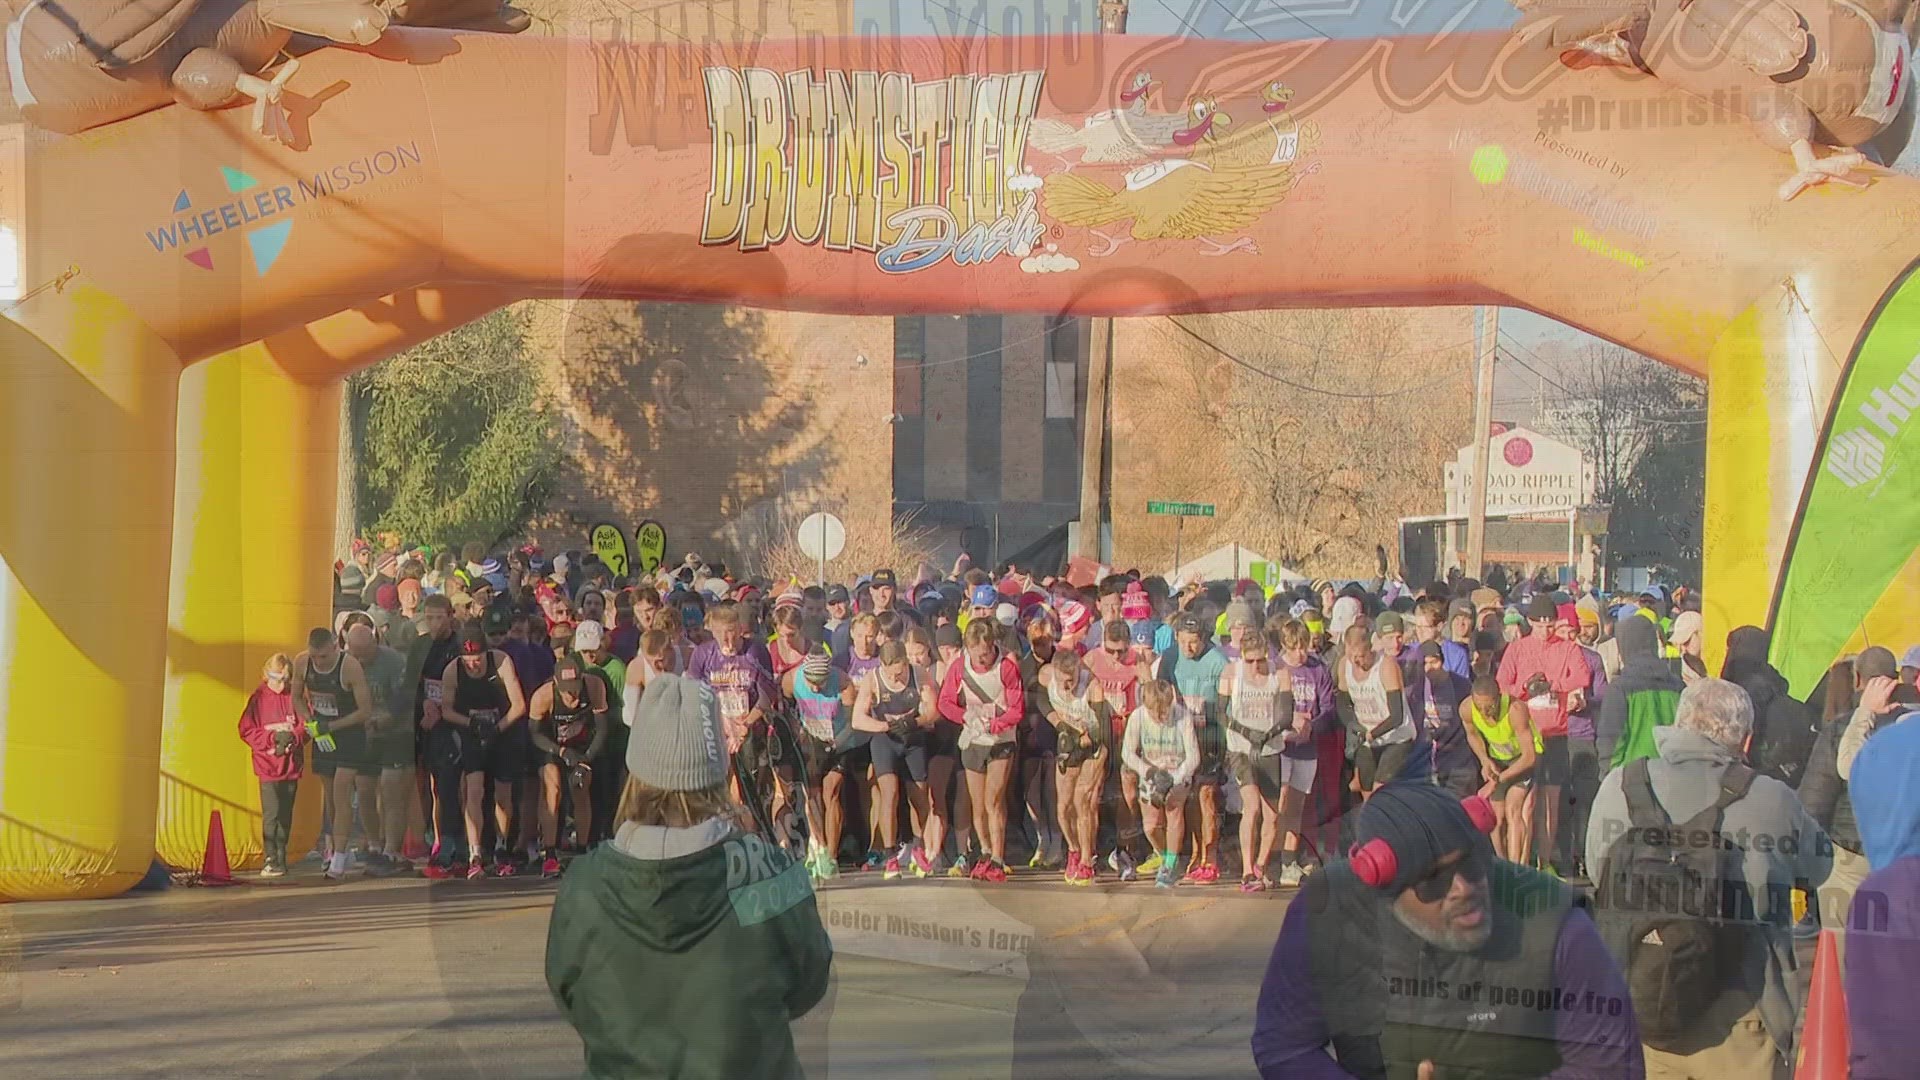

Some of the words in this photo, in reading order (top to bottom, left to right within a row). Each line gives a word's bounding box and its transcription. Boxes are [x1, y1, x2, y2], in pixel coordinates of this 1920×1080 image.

[1537, 78, 1874, 137] #DrumstickDa
[700, 66, 1045, 253] DRUMSTICK
[1533, 129, 1608, 170] Presented
[1611, 155, 1630, 180] by
[145, 186, 296, 253] WHEELER
[297, 140, 421, 203] MISSION
[876, 192, 1045, 273] Dash
[1463, 473, 1516, 488] BAD
[1522, 473, 1576, 488] RIPPLE
[1509, 493, 1573, 506] SCHOOL
[597, 529, 616, 540] Ask
[642, 527, 660, 538] Ask
[700, 704, 718, 762] move
[1602, 818, 1798, 855] Presented
[887, 913, 981, 949] Mission's
[1383, 976, 1450, 1000] ands
[1458, 981, 1482, 1003] of
[1489, 984, 1577, 1012] people
